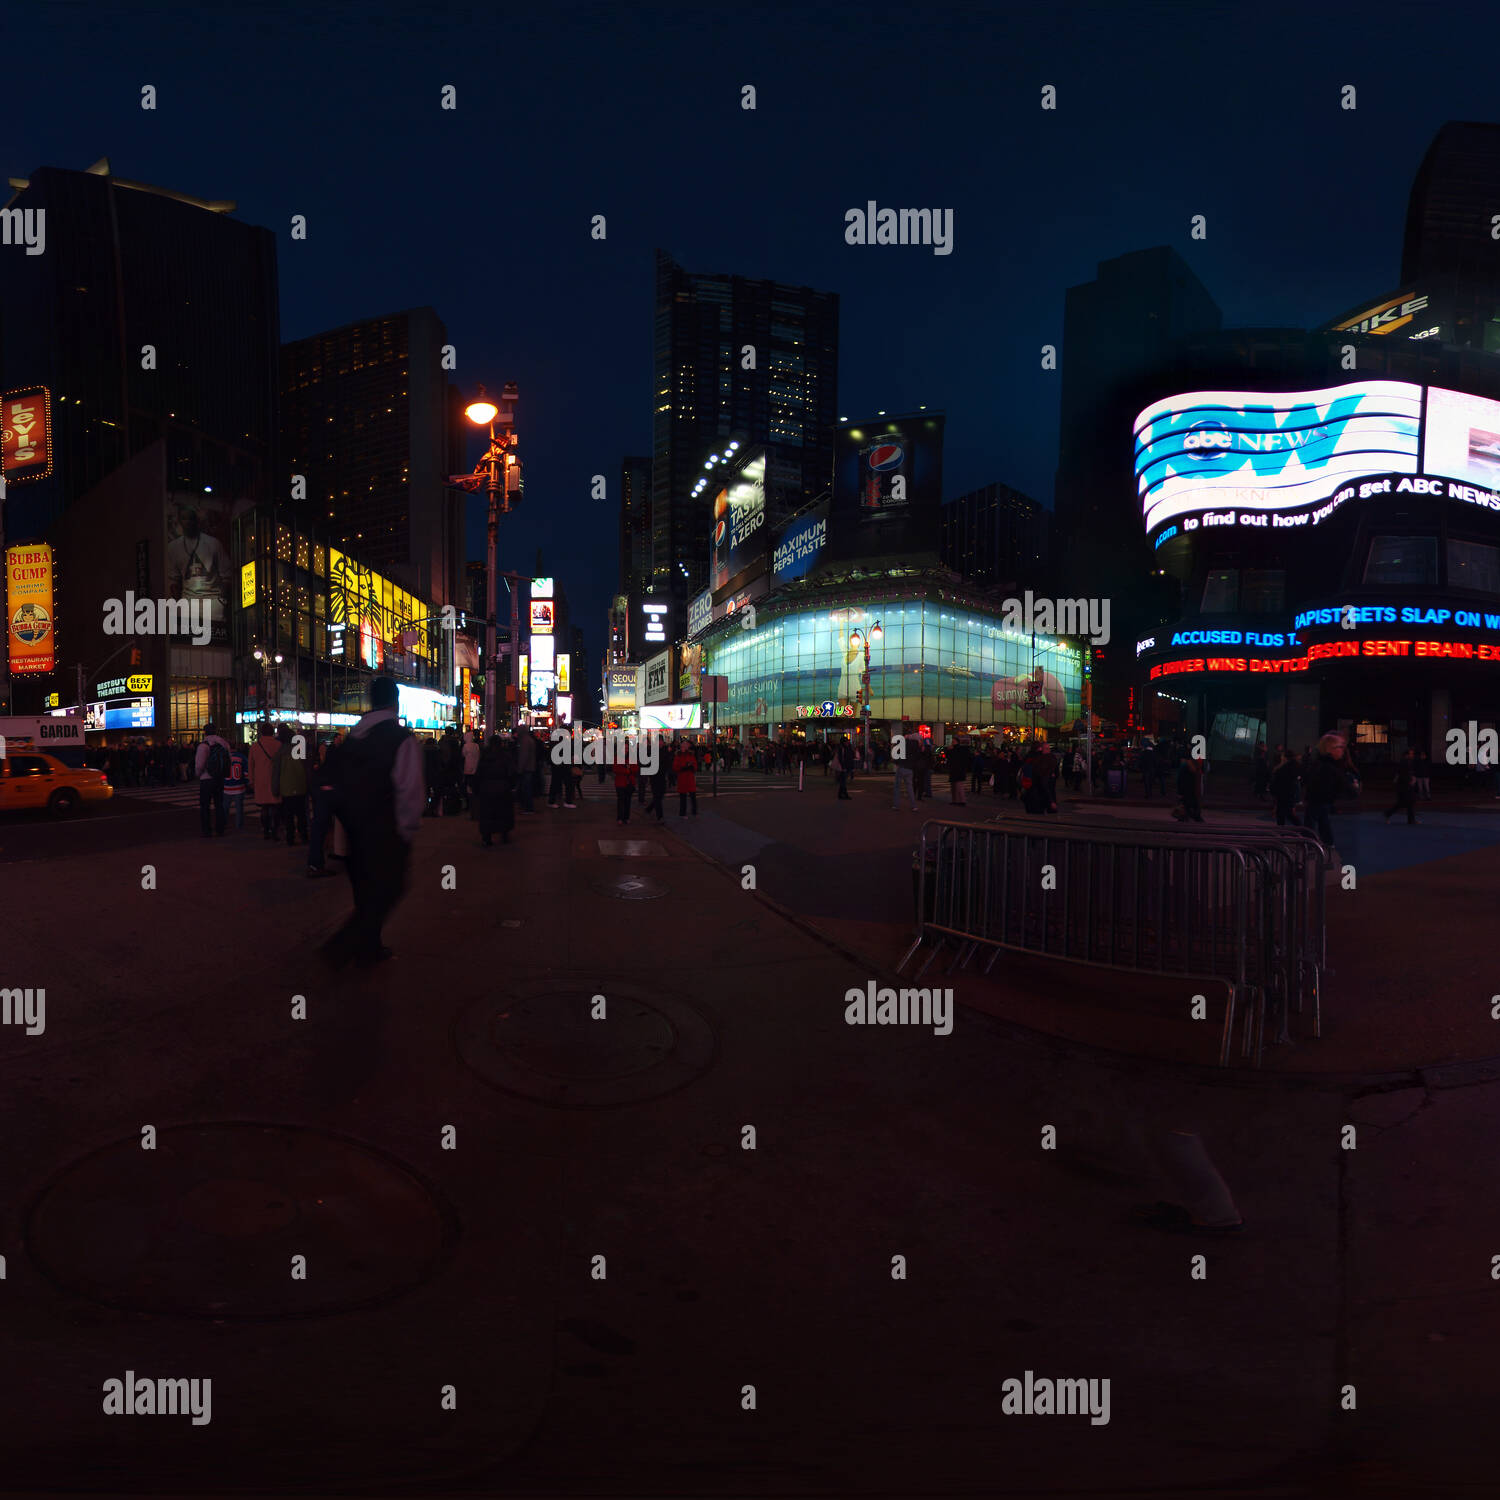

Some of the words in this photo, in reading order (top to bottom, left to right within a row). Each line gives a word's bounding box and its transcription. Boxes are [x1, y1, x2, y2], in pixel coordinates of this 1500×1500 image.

[1238, 426, 1328, 451] NEWS
[1184, 519, 1199, 531] to
[1203, 511, 1236, 526] find
[1240, 512, 1268, 527] out
[1273, 513, 1310, 527] how
[1312, 503, 1334, 525] you
[1333, 488, 1354, 508] can
[1359, 479, 1391, 499] get
[1396, 478, 1443, 496] ABC
[731, 535, 738, 550] A
[739, 512, 765, 543] ZERO
[774, 519, 827, 562] MAXIMUM
[9, 552, 49, 566] BUBBA
[774, 554, 794, 574] PEPSI
[796, 534, 826, 559] TASTE
[12, 567, 47, 581] GUMP
[399, 600, 412, 615] THE
[688, 592, 713, 623] ZERO
[1348, 607, 1397, 623] GETS
[1401, 607, 1451, 624] SLAP
[1455, 611, 1481, 628] ON
[1171, 631, 1242, 646] ACCUSED
[1246, 632, 1284, 647] FLDS
[1363, 641, 1413, 656] SENT
[1206, 657, 1248, 673] WINS
[648, 667, 666, 690] FAT
[754, 679, 778, 694] sunny
[97, 686, 126, 697] THEATER
[40, 725, 79, 738] GARDA
